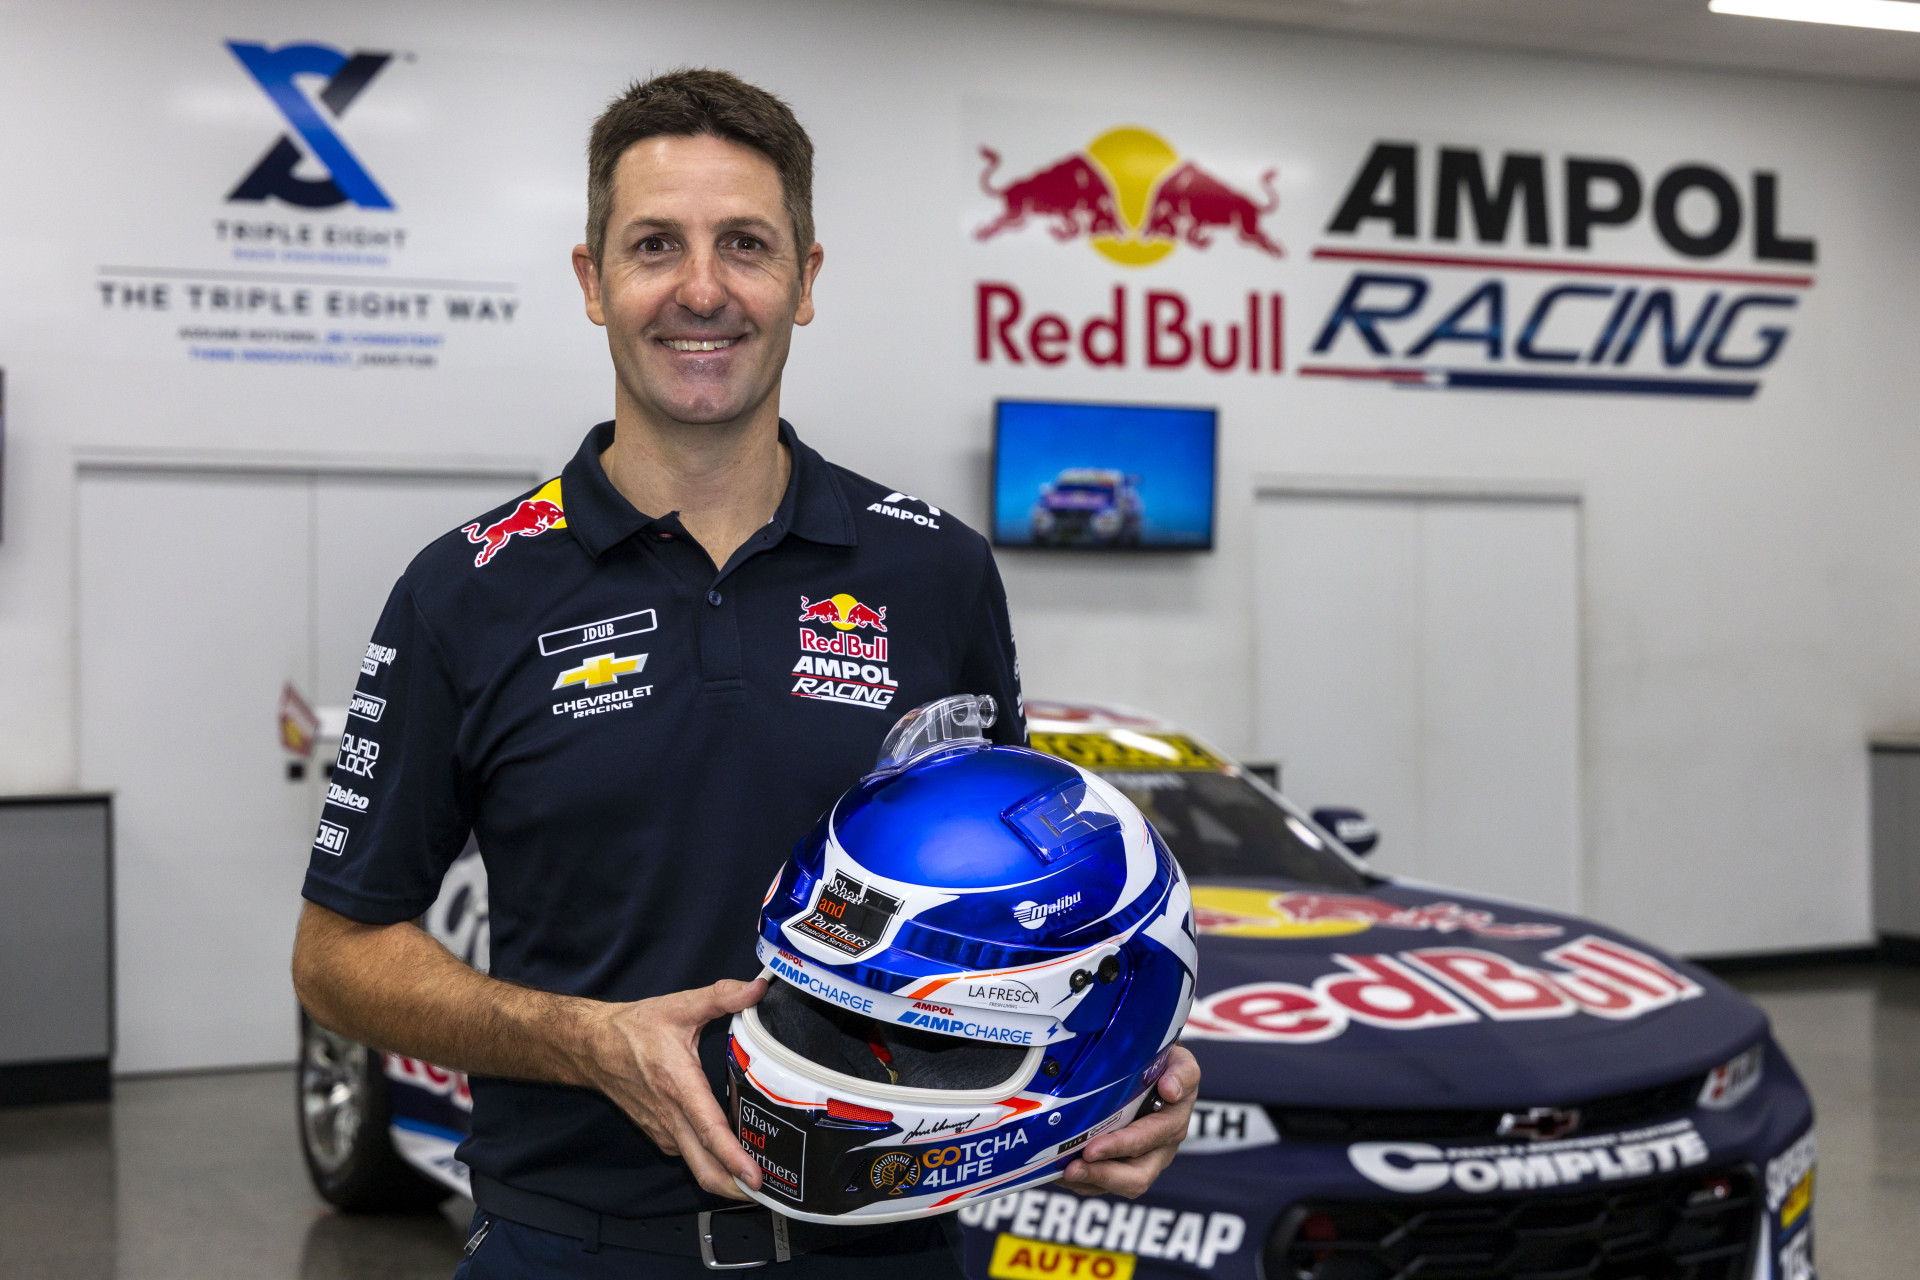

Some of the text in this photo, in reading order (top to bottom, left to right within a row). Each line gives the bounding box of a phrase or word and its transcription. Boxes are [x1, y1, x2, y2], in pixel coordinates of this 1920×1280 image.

[1325, 140, 1816, 264] AMPOL
[215, 220, 407, 248] TRIPLE EIGHT
[99, 282, 519, 322] THE TRIPLE EIGHT WAY
[977, 281, 1284, 375] Red Bull
[1311, 271, 1800, 370] RACING
[867, 503, 940, 529] AMPOL
[582, 623, 615, 642] JDUB
[800, 628, 887, 662] Red Bull
[792, 655, 898, 687] AMPOL
[552, 685, 654, 715] CHEVROLET
[791, 677, 895, 705] RACING
[573, 701, 634, 719] RACING
[341, 733, 380, 760] QUAD
[336, 750, 377, 779] LOCK
[327, 783, 370, 810] Delco
[316, 824, 345, 851] JGI
[818, 897, 847, 919] and
[796, 922, 859, 953] Financial Services
[808, 912, 871, 948] Partners
[778, 948, 803, 968] AMPOL
[776, 962, 874, 1014] AMPCHARGE
[1398, 934, 1704, 1021] Bull
[912, 1001, 954, 1016] AMPOL
[968, 985, 1039, 1004] LA FRESCA
[914, 1014, 1033, 1044] AMPCHARGE
[742, 1105, 780, 1138] Shaw
[1193, 1108, 1247, 1139] TH
[741, 1127, 766, 1150] and
[922, 1128, 1028, 1169] GOTCHA
[769, 1176, 798, 1196] Services
[922, 1157, 994, 1188] 4LIFE
[1007, 1245, 1118, 1279] AUTO
